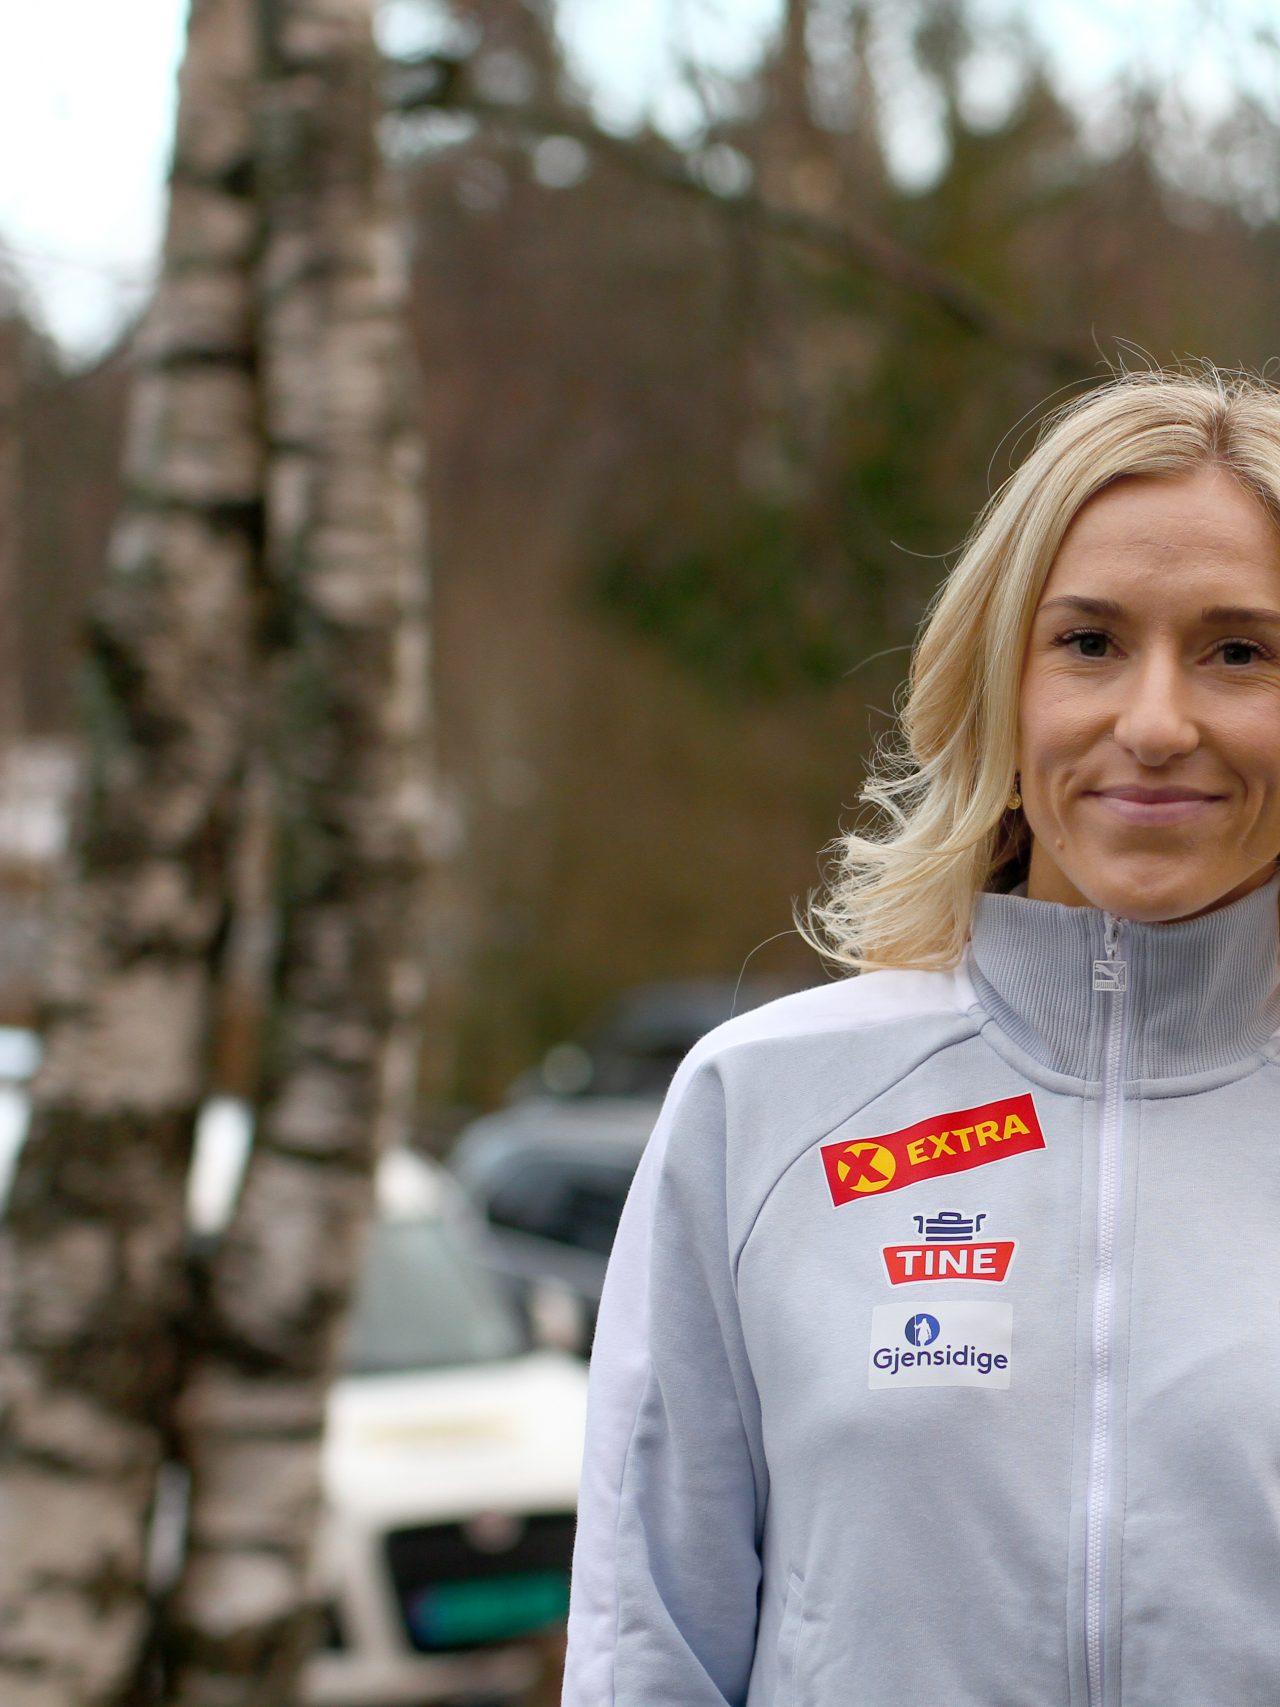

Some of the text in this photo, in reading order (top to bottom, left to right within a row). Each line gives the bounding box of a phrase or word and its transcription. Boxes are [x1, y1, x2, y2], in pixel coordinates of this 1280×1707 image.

[906, 1114, 1030, 1167] EXTRA
[896, 1248, 997, 1277] TINE
[873, 1345, 1008, 1375] Gjensidige
